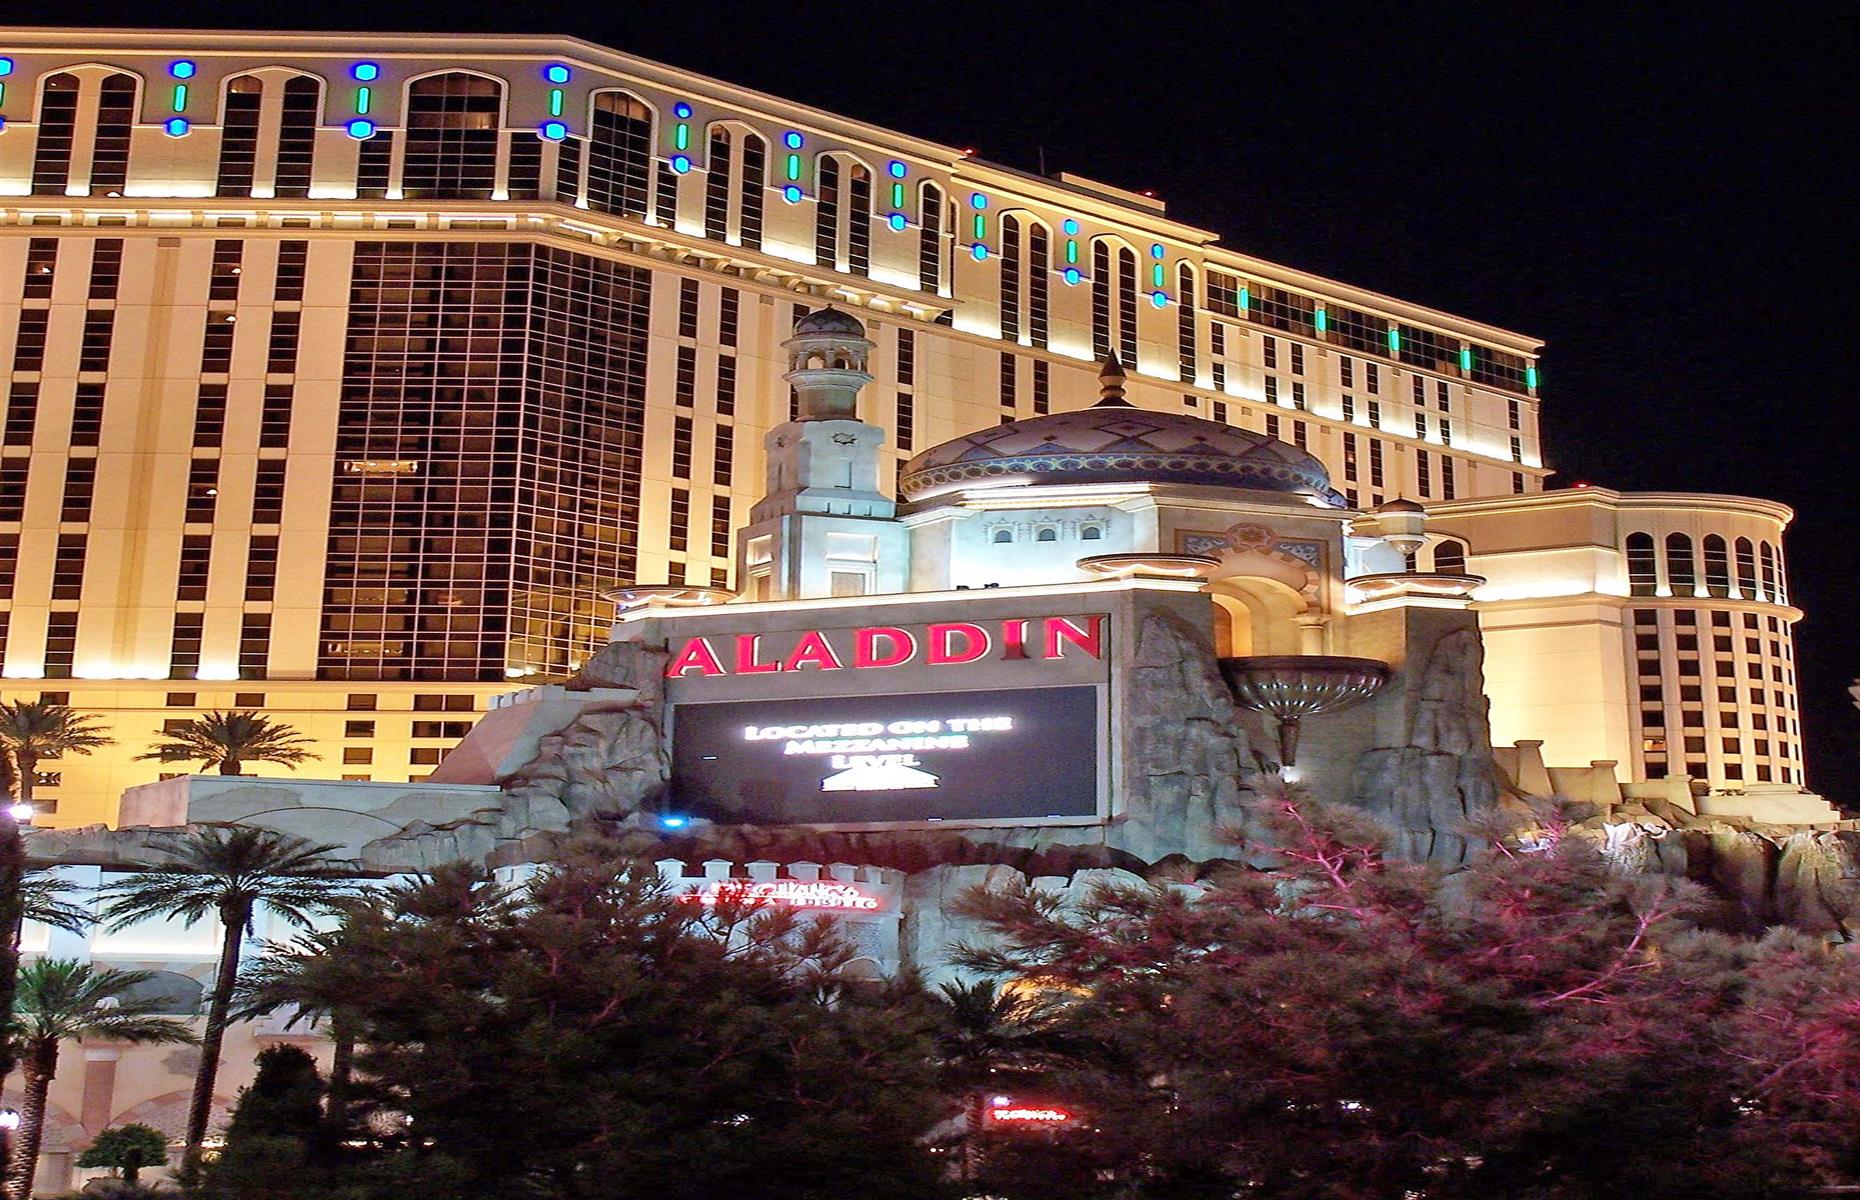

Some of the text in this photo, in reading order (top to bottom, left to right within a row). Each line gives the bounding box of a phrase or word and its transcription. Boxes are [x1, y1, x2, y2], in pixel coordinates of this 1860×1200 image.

[665, 616, 1105, 677] ALADDIN
[744, 716, 1013, 741] LOCATED ON THE
[783, 734, 970, 755] MEZZANINE
